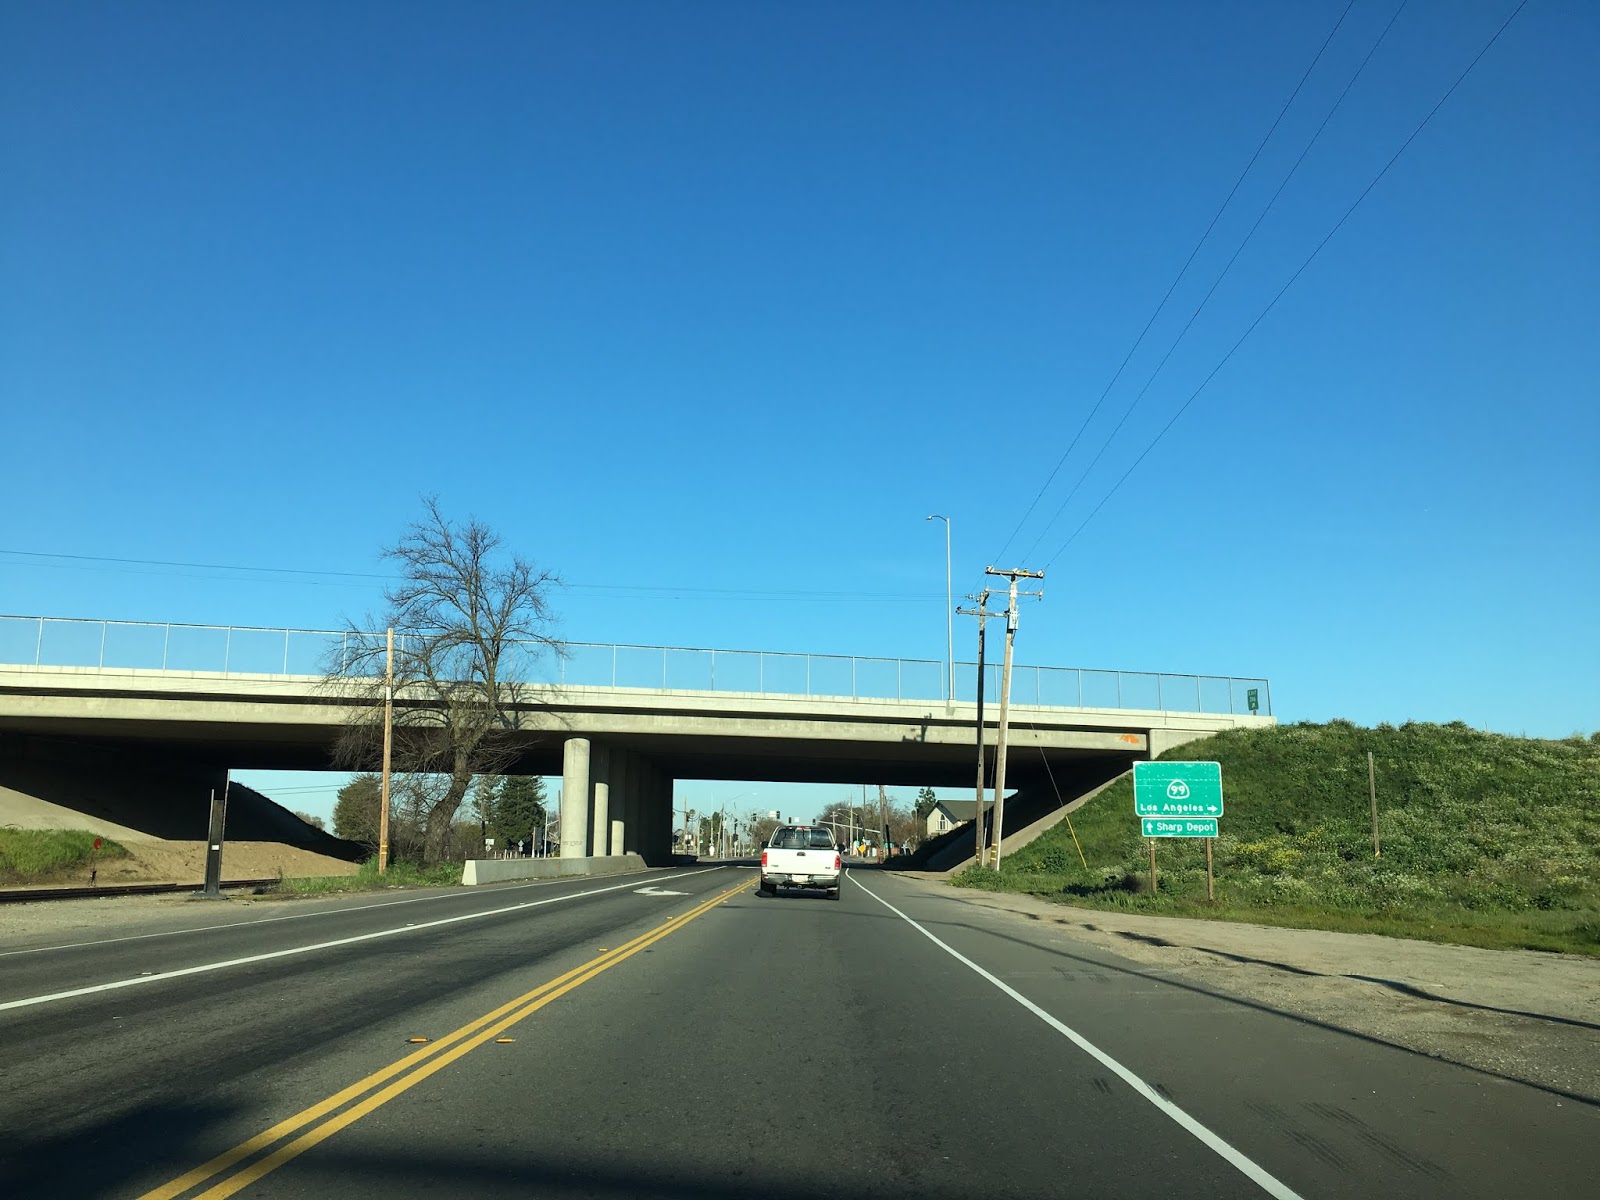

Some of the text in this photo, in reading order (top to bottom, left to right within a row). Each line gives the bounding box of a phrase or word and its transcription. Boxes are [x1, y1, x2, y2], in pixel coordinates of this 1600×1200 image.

[1171, 785, 1185, 795] 99
[1140, 803, 1203, 814] Los Angeles
[1156, 822, 1214, 833] Sharp Depot
